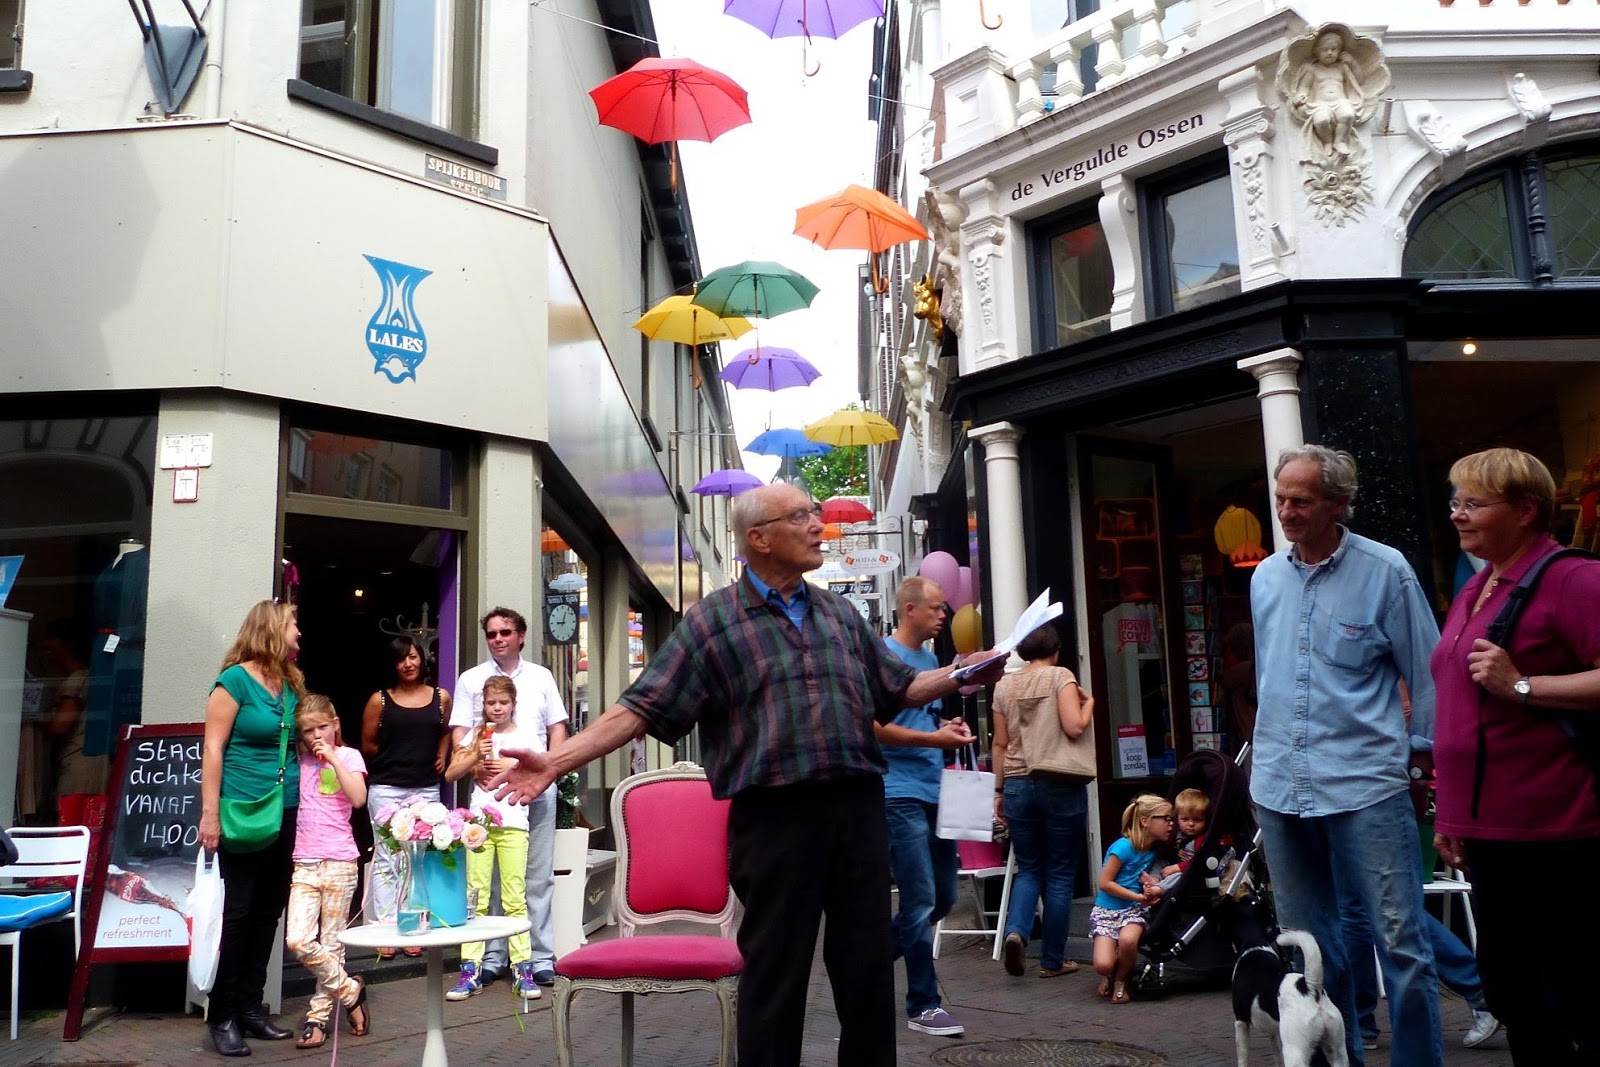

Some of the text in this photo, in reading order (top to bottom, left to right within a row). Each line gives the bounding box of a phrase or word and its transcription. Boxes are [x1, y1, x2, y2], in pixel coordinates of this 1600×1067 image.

[1011, 114, 1204, 201] de Vergulde Ossen
[427, 157, 501, 191] SPIJKERBOOR
[369, 328, 424, 353] LALES
[830, 583, 846, 594] Top
[1126, 753, 1143, 763] koop
[1123, 761, 1147, 771] zondag
[126, 794, 195, 815] VANAF
[118, 914, 161, 927] perfect
[102, 927, 173, 939] refreshment
